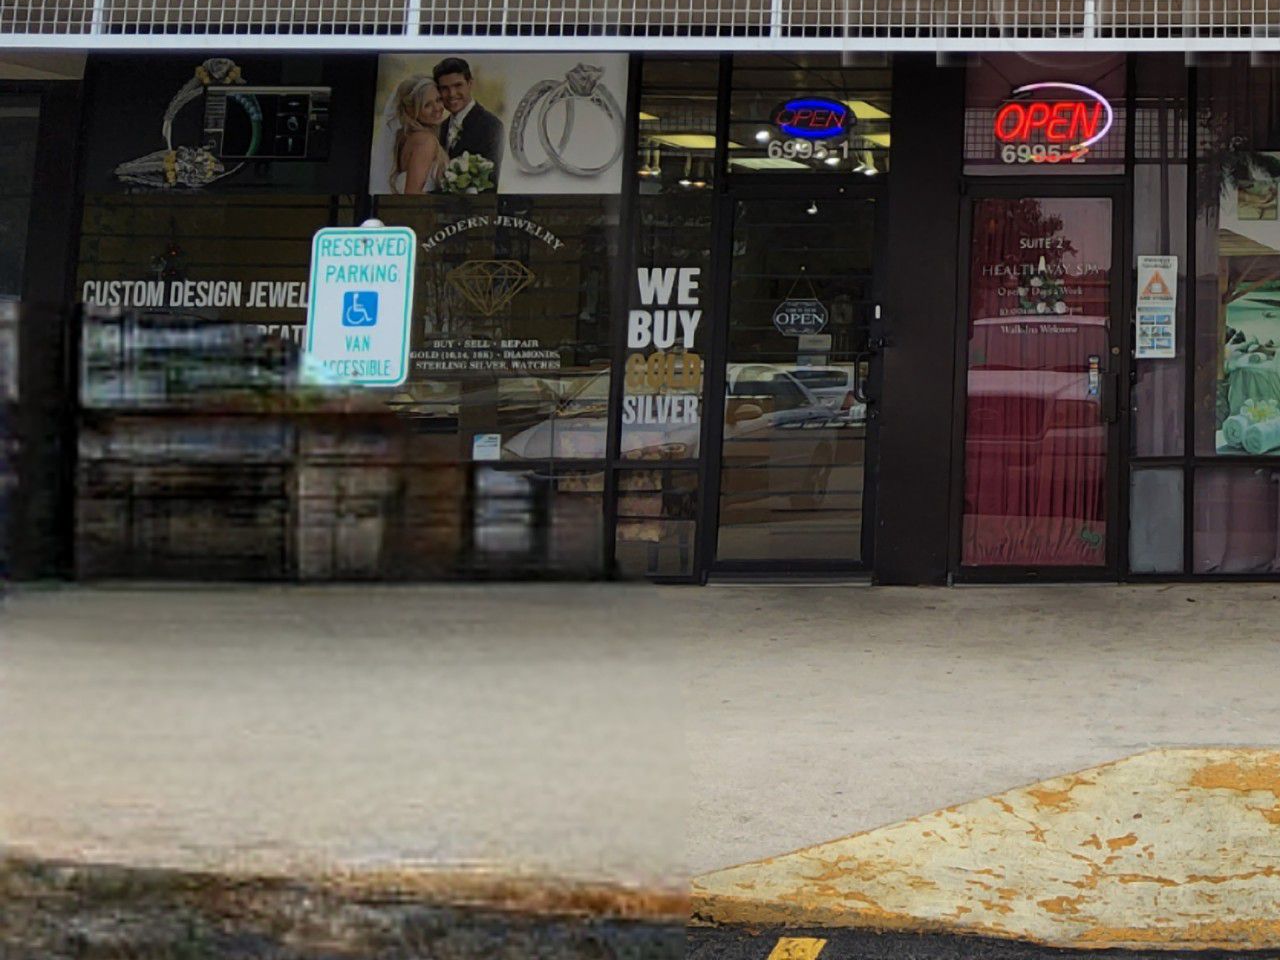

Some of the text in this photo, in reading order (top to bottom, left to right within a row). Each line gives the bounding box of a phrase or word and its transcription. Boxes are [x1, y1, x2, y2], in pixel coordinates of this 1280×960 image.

[775, 108, 847, 129] OPEN
[995, 101, 1102, 142] OPEN
[768, 139, 849, 159] 6995-1
[1001, 144, 1088, 163] 6995-2
[421, 215, 566, 253] MODERN JEWELRY
[1019, 237, 1064, 249] SUITE 2
[321, 238, 407, 256] RESERVED
[326, 264, 398, 283] PARKING
[82, 280, 165, 307] CUSTOM
[169, 280, 242, 307] DESIGN
[637, 267, 701, 305] WE
[775, 312, 825, 325] OPEN
[627, 310, 702, 348] BUY
[345, 335, 370, 352] VAN
[433, 339, 539, 349] BUY SELL REPAIR
[410, 351, 439, 360] GOLD
[416, 361, 466, 370] STERLING
[511, 361, 561, 370] WATCHES
[625, 351, 701, 389] GOLD
[622, 394, 699, 425] SILVER
